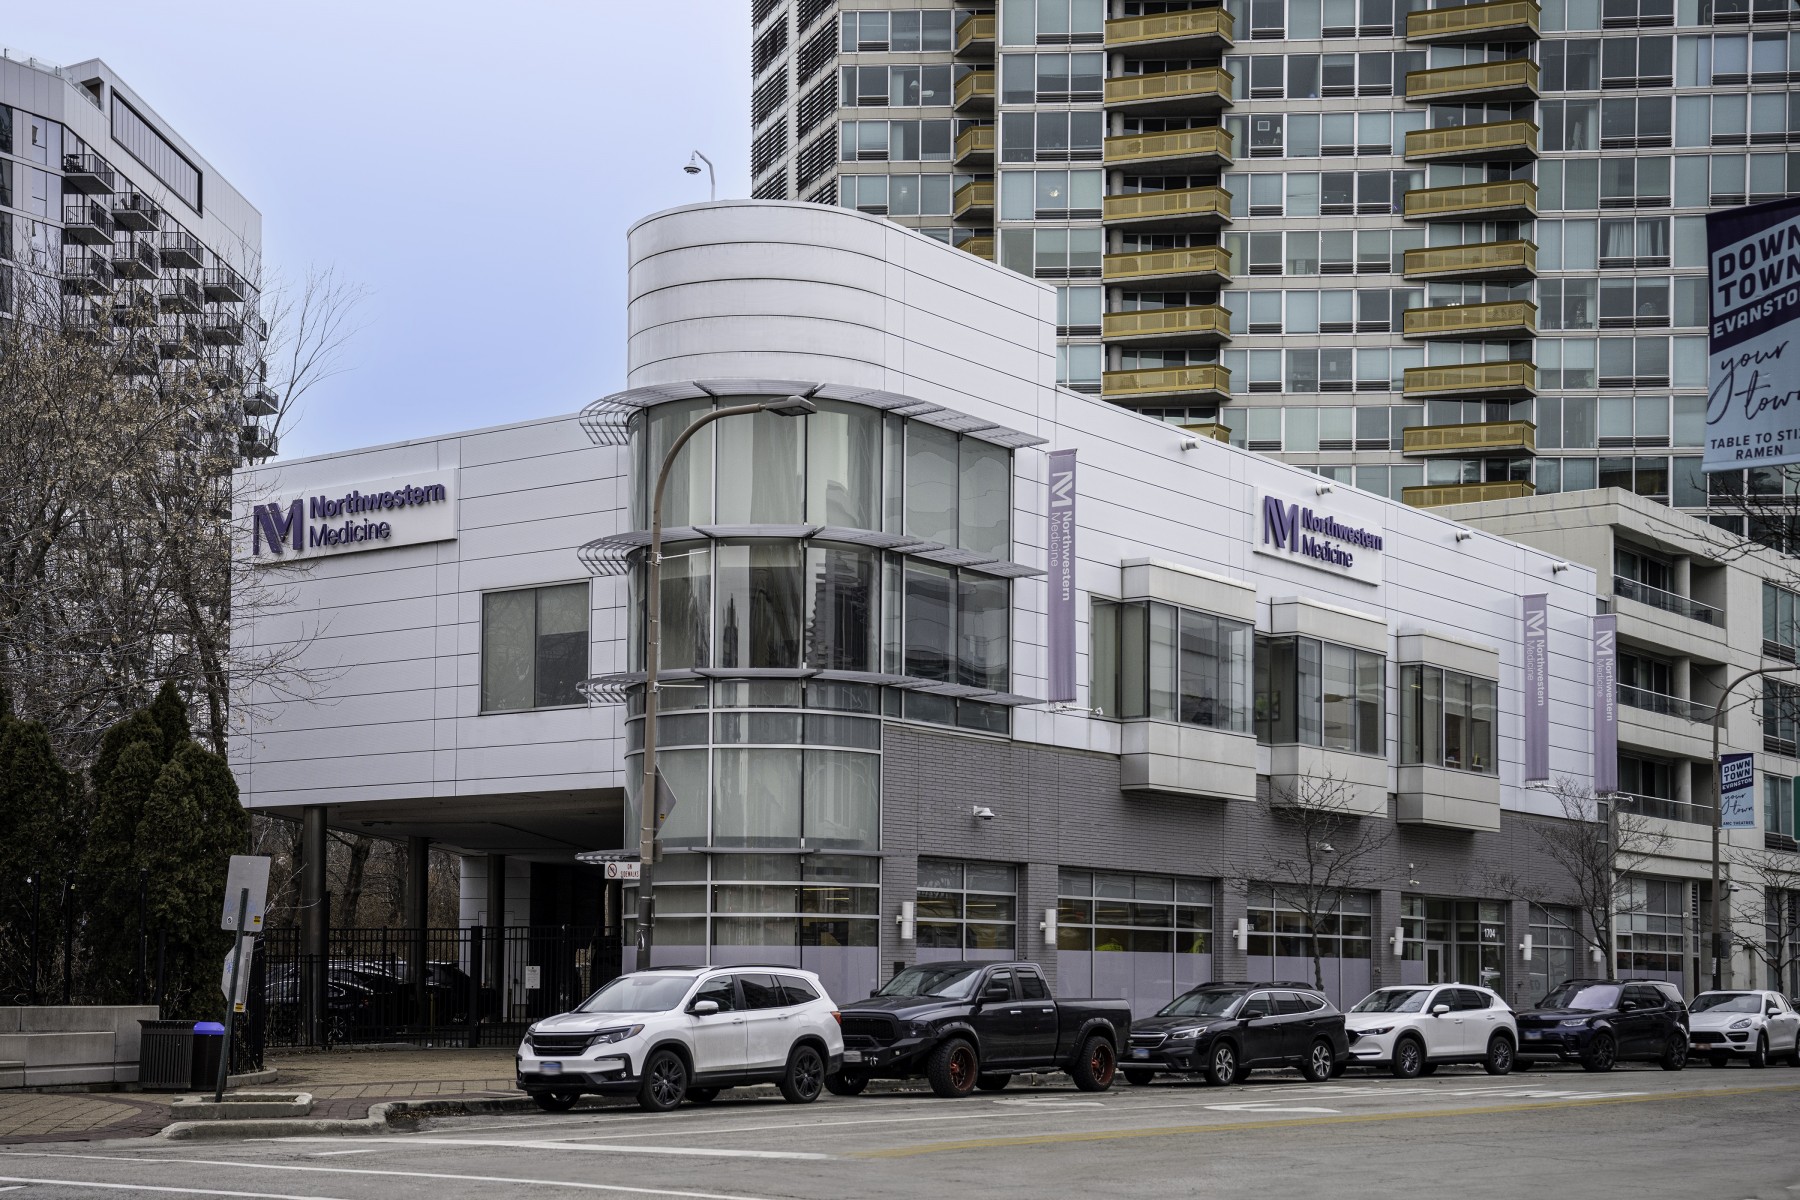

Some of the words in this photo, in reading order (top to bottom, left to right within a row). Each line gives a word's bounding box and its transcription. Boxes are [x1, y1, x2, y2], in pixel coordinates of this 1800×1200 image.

[1719, 224, 1800, 280] DOWN
[1718, 254, 1800, 307] TOWN
[1713, 289, 1800, 338] EVANSTO
[1706, 341, 1789, 425] your
[1735, 370, 1800, 420] tow
[1711, 435, 1750, 449] TABLE
[1756, 432, 1772, 444] TO
[1777, 428, 1800, 442] STI
[1736, 445, 1783, 460] RAMEN
[309, 483, 446, 519] Northwestern
[309, 518, 392, 548] Medicine
[1051, 512, 1061, 567] Medicine
[1302, 507, 1383, 551] Northwestern
[1062, 511, 1073, 601] Northwestern
[1302, 534, 1354, 567] Medicine
[1526, 640, 1536, 681] Medicine
[1536, 639, 1545, 706] Northwestern
[1596, 659, 1605, 698] Medicine
[1605, 658, 1614, 721] Northwestern
[1722, 777, 1752, 790] EVANSTON
[1724, 759, 1750, 773] DOWN
[1724, 768, 1750, 781] TOWN
[1484, 928, 1496, 938] 1704
